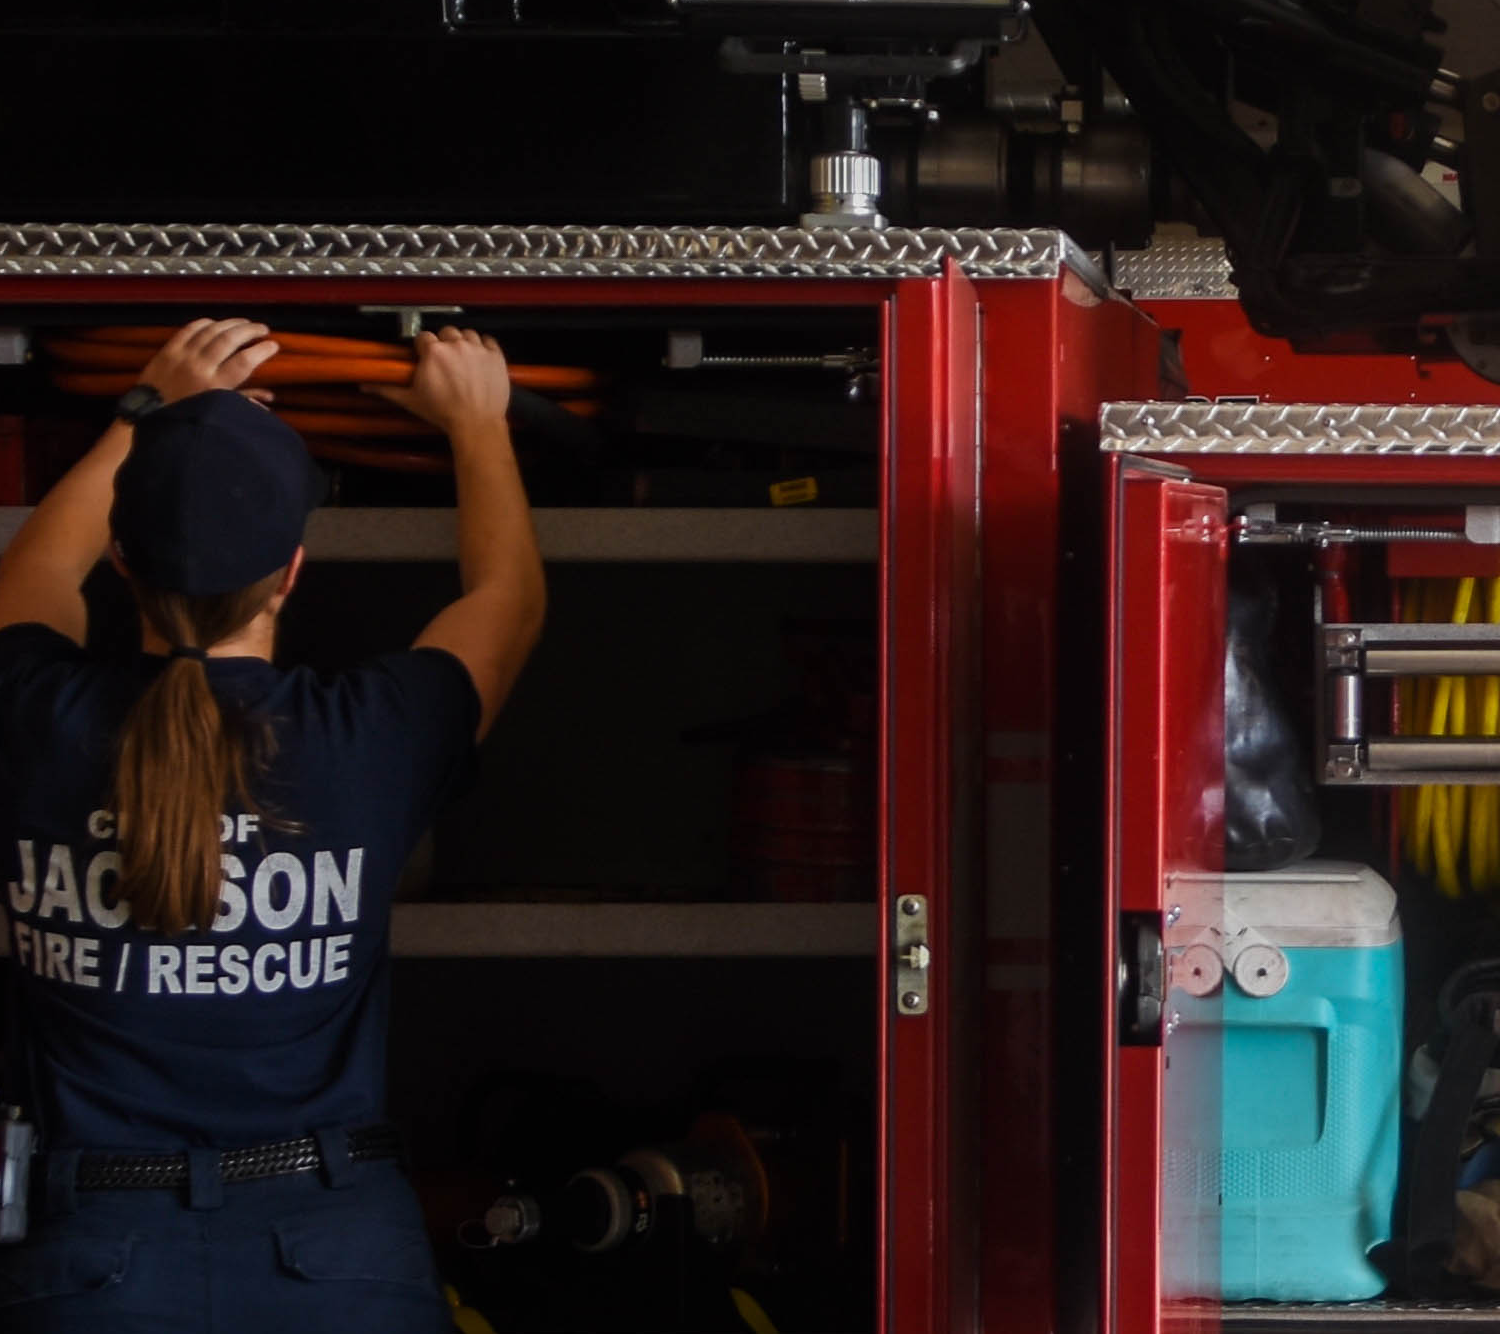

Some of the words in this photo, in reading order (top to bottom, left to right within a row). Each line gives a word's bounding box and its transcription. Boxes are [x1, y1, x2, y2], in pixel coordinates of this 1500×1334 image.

[7, 838, 365, 932] JACSON
[14, 920, 102, 988] FIRE
[115, 942, 132, 993] /
[148, 934, 354, 996] RESCUE
